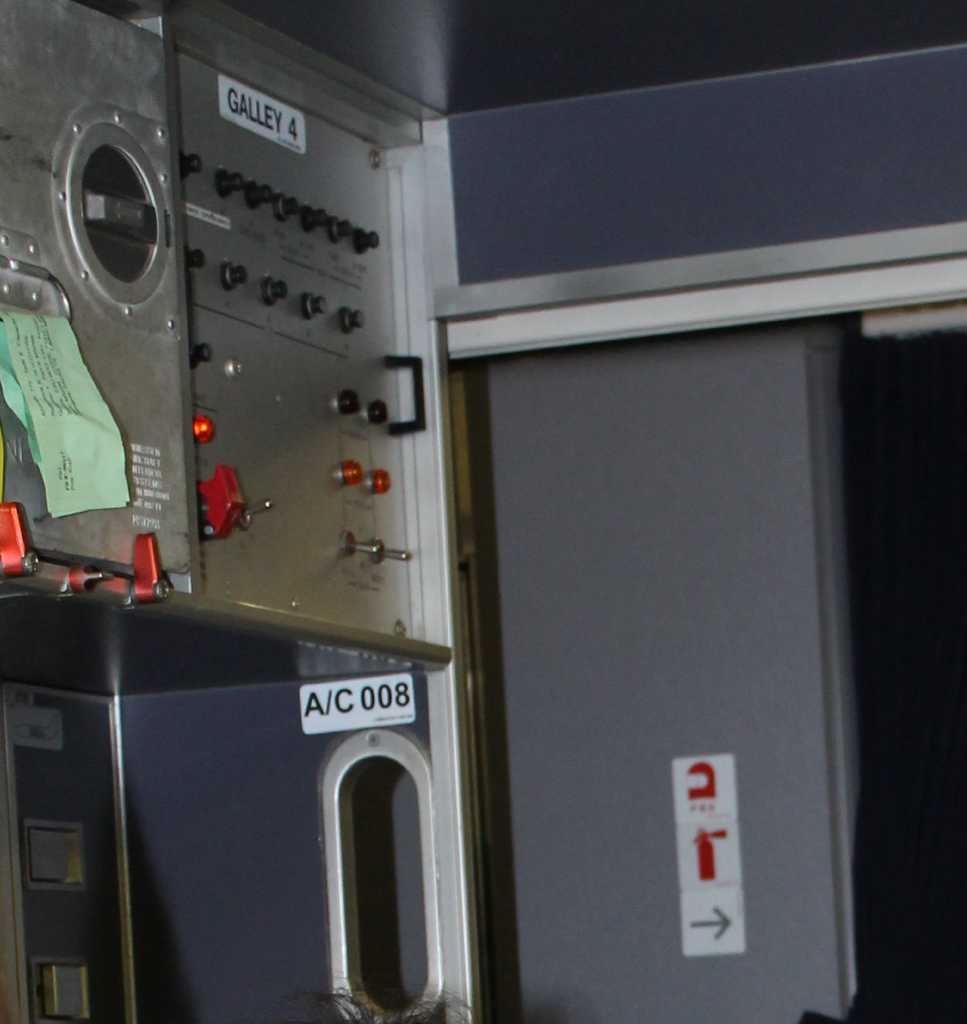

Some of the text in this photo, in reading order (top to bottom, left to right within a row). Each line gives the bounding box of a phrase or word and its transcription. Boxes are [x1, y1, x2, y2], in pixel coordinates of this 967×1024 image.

[227, 87, 298, 141] GALLEY 4
[304, 682, 411, 717] A/C 008
